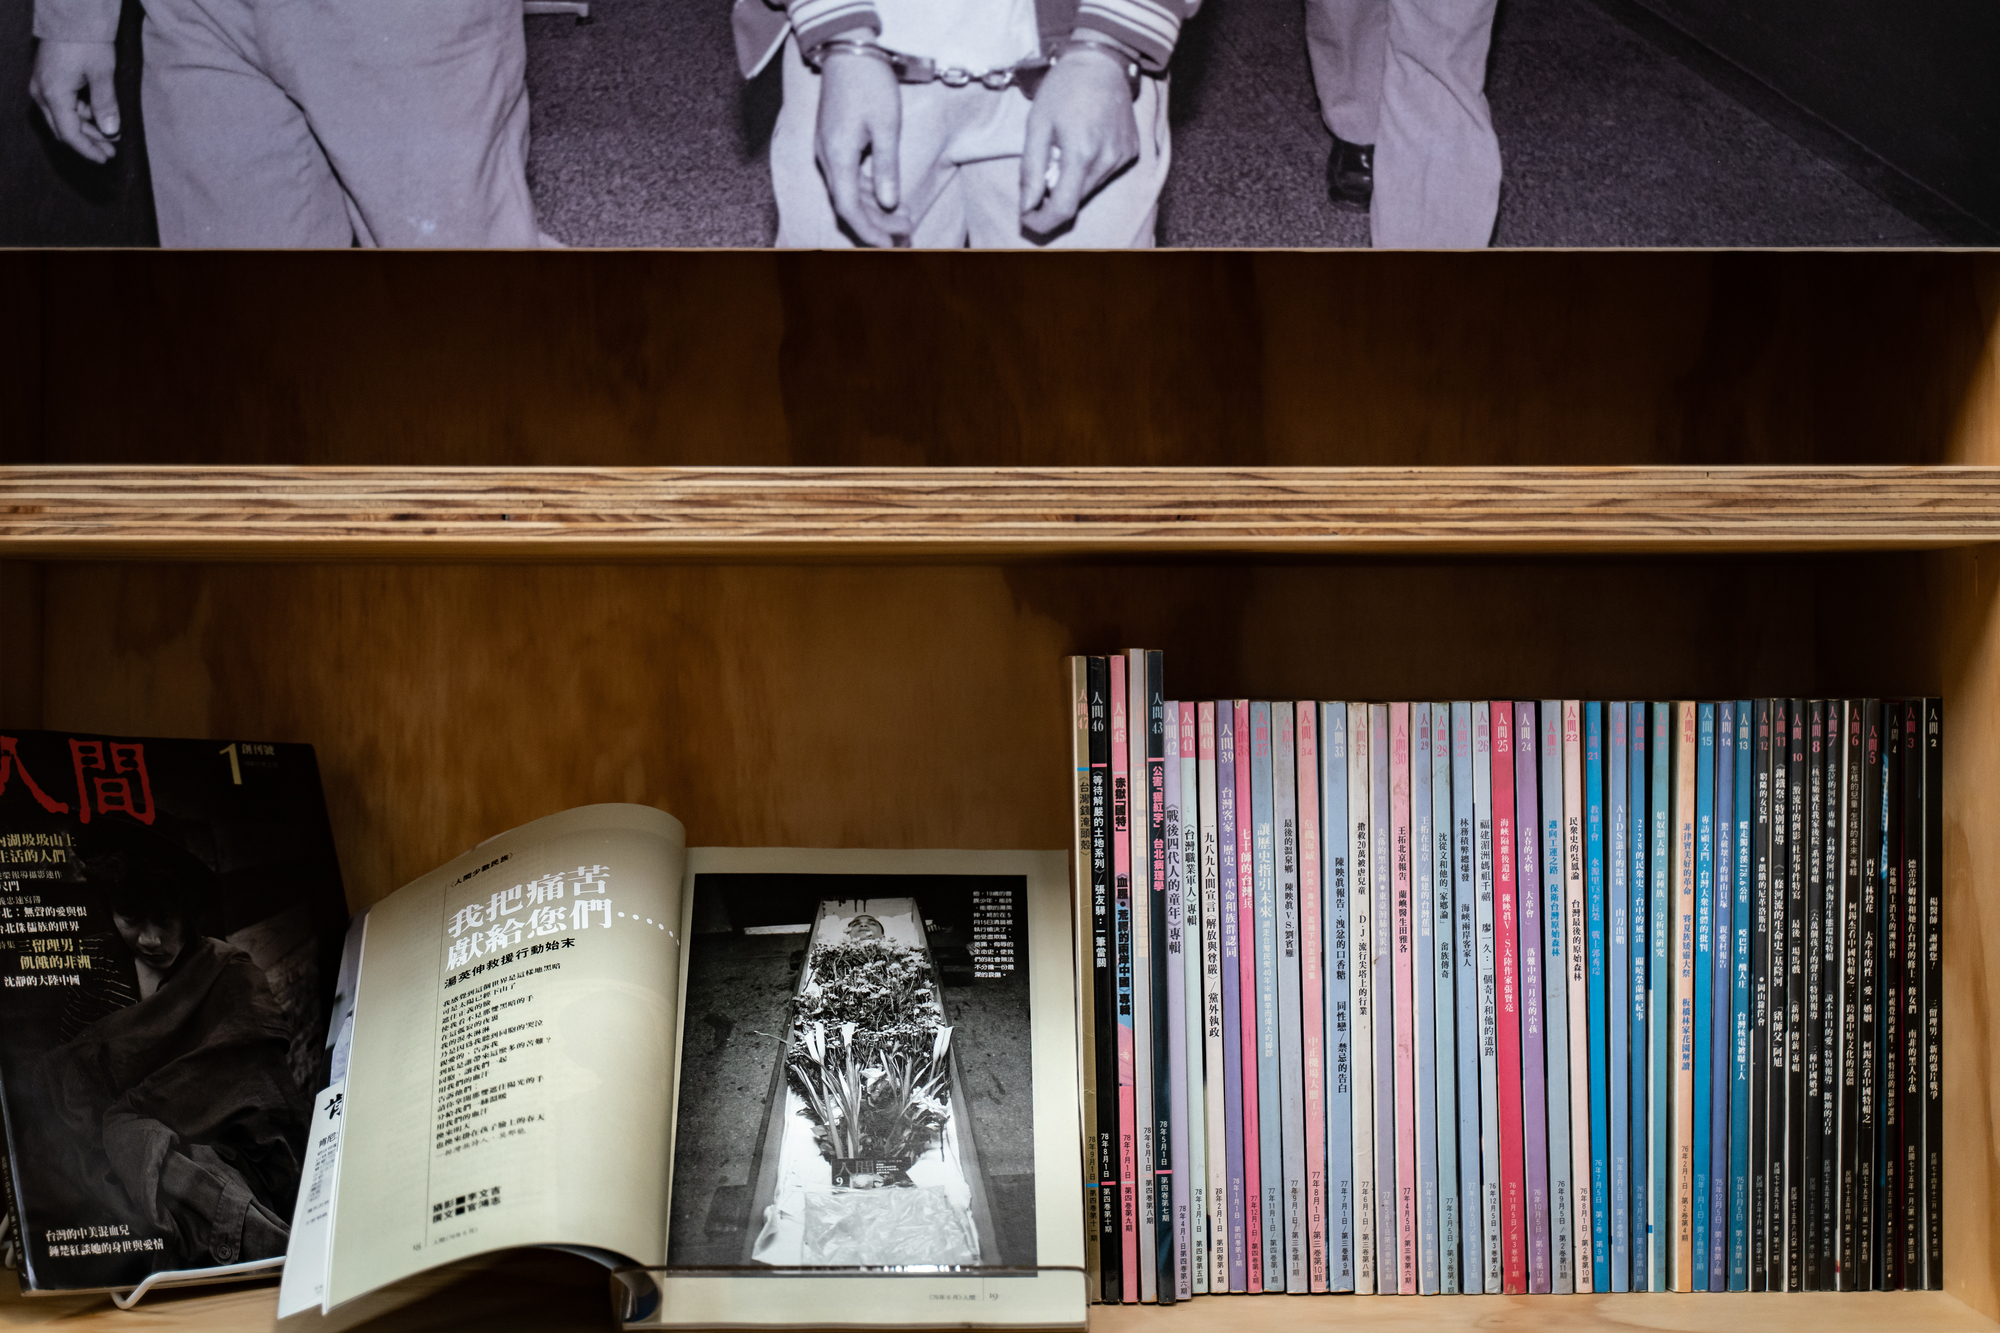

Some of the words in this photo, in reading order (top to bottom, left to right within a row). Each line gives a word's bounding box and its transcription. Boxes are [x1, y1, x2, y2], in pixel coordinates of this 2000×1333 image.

[219, 743, 242, 785] 1
[1284, 819, 1294, 873] 最後的溫泉鄉
[1549, 820, 1558, 875] 邁向工運之路
[1590, 805, 1599, 841] 教師工會
[1240, 829, 1253, 908] 七十師的台灣兵
[1257, 822, 1272, 918] 讓歷史指引未來
[1397, 826, 1407, 881] 王拓北京報告
[1460, 818, 1469, 882] 林務積弊總爆發
[1480, 819, 1491, 902] 福建湄洲媽祖千禧
[1500, 818, 1510, 882] 海峽隔離後遺症
[1683, 822, 1692, 895] 菲律賓美好的革命
[448, 864, 610, 939] 我把痛苦
[1398, 890, 1408, 953] 蘭嶼醫生田雅各
[1550, 884, 1560, 956] 保衛台灣原始森林
[1461, 904, 1471, 967] 海峽兩岸客家人
[1571, 900, 1582, 981] 台灣最後的原始森林
[1719, 926, 1728, 968] 親愛村報告
[444, 937, 576, 990] 湯英伸救援行動始末
[1634, 957, 1644, 1021] 關曉榮蘭嶼紀事
[1907, 1029, 1917, 1093] 南非的黑人小孩
[1088, 1136, 1096, 1181] 78年9月1日
[1101, 1133, 1110, 1178] 78年8月1日
[1123, 1134, 1131, 1179] 78年7月1日
[1143, 1127, 1152, 1172] 78年6月1日
[1159, 1121, 1168, 1166] 78年5月1日
[1089, 1189, 1098, 1242] 第四卷第十一期
[1103, 1188, 1112, 1233] 第四卷第十期
[1124, 1187, 1133, 1232] 第四卷第九期
[1145, 1180, 1154, 1224] 第四卷第八期
[1160, 1176, 1170, 1222] 第四卷第七期
[1195, 1189, 1203, 1233] 78年3月1日
[46, 1224, 130, 1242] 台灣的中美混血兒
[1196, 1240, 1204, 1285] 第四卷第五期
[1216, 1239, 1224, 1283] 第四卷第4期
